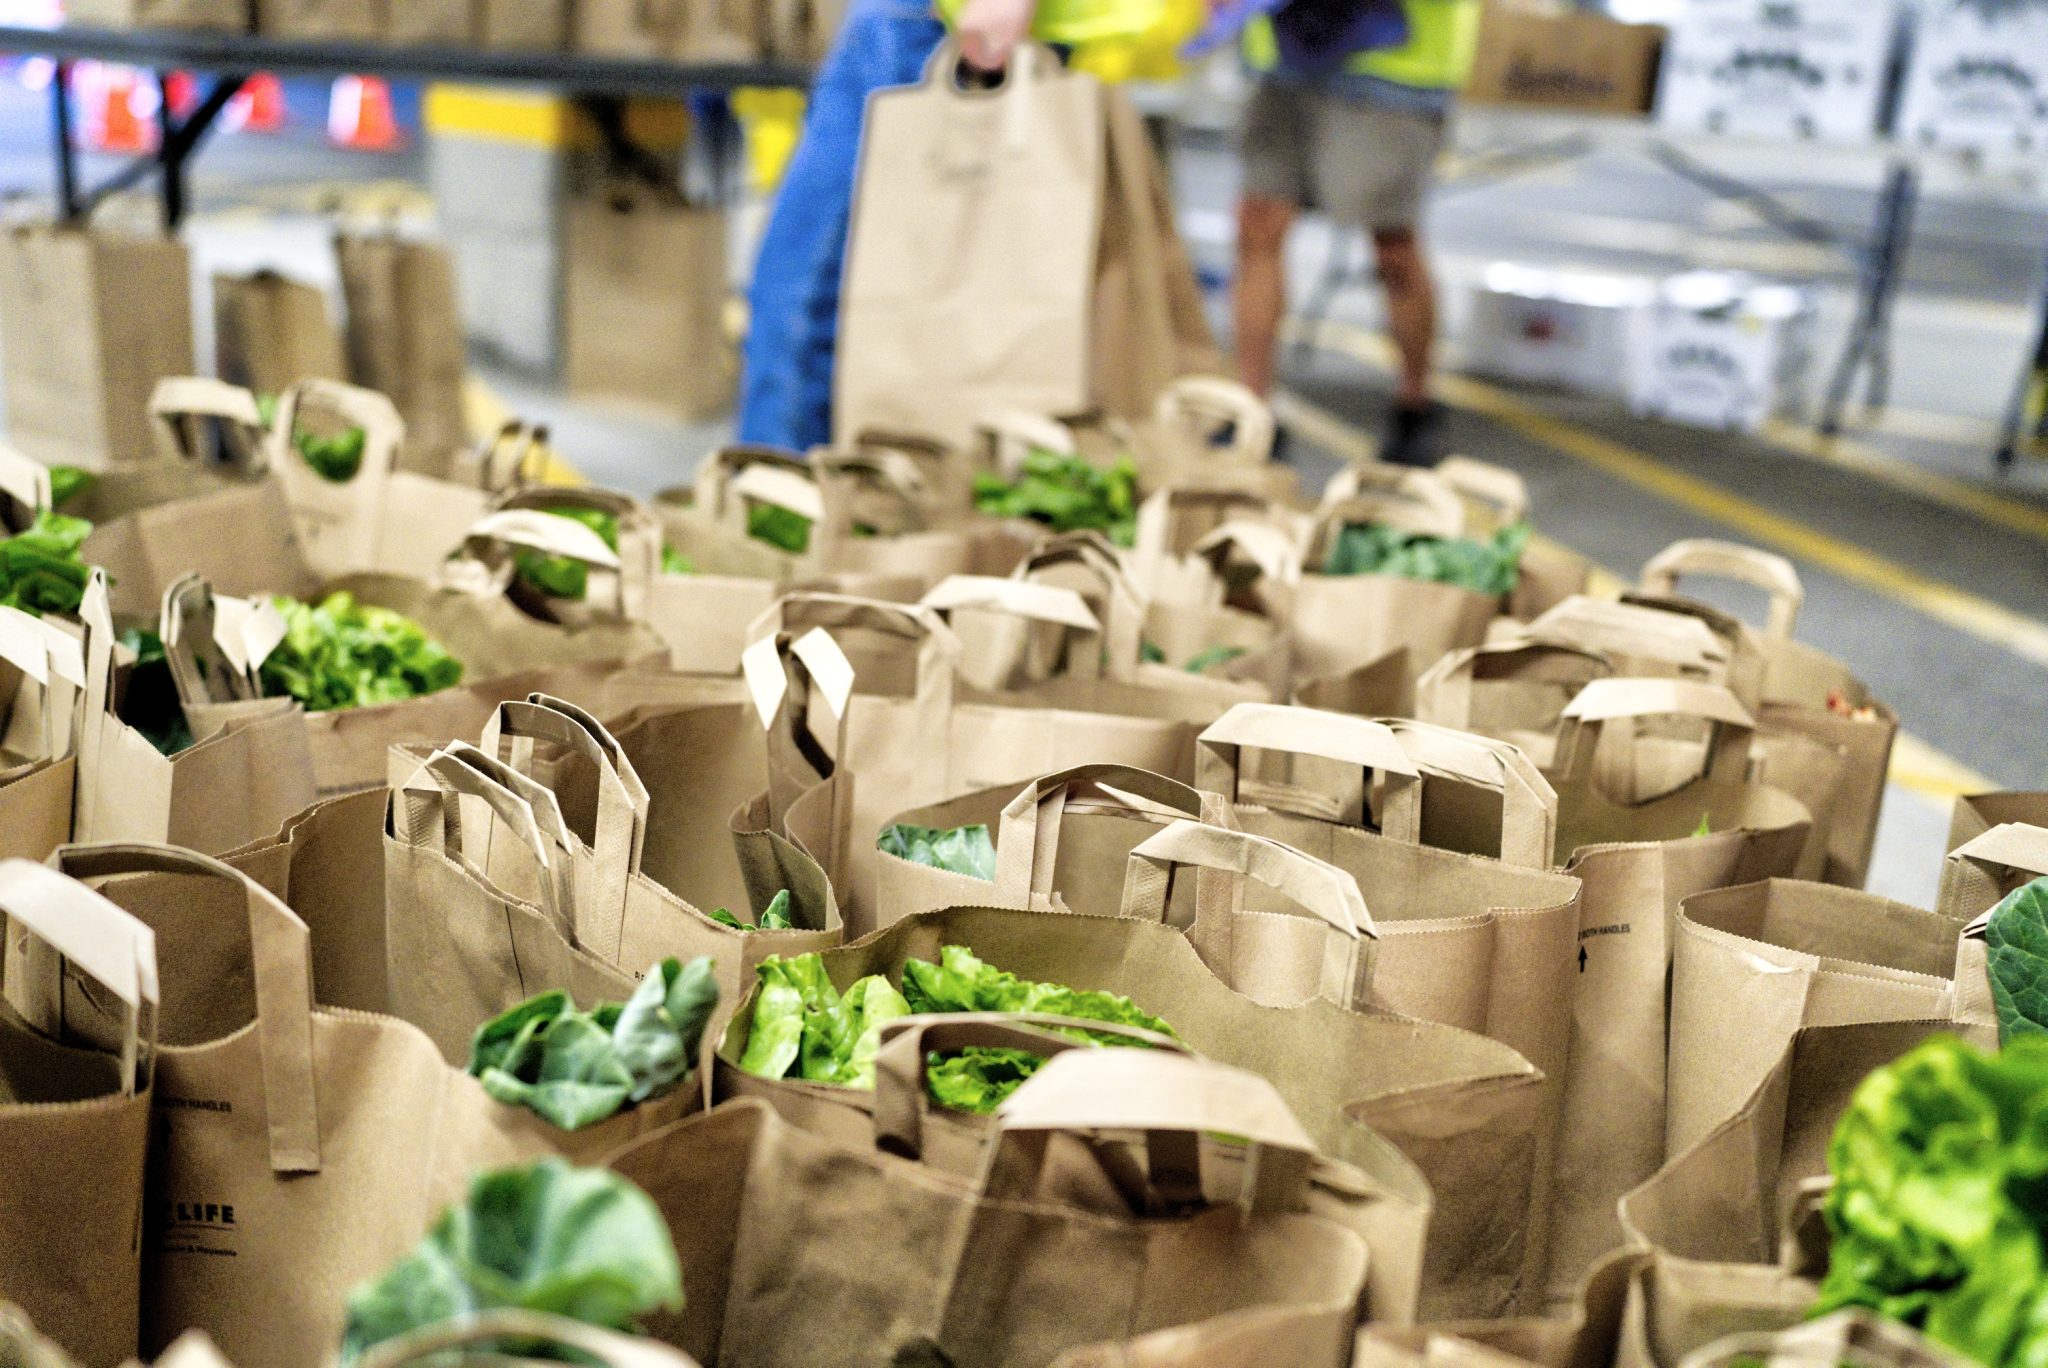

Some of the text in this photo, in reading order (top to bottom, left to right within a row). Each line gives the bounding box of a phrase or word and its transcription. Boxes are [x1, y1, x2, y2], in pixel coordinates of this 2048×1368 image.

[1599, 923, 1630, 936] HANDLES
[188, 1098, 232, 1112] HANDLES
[177, 1203, 235, 1224] LIFE
